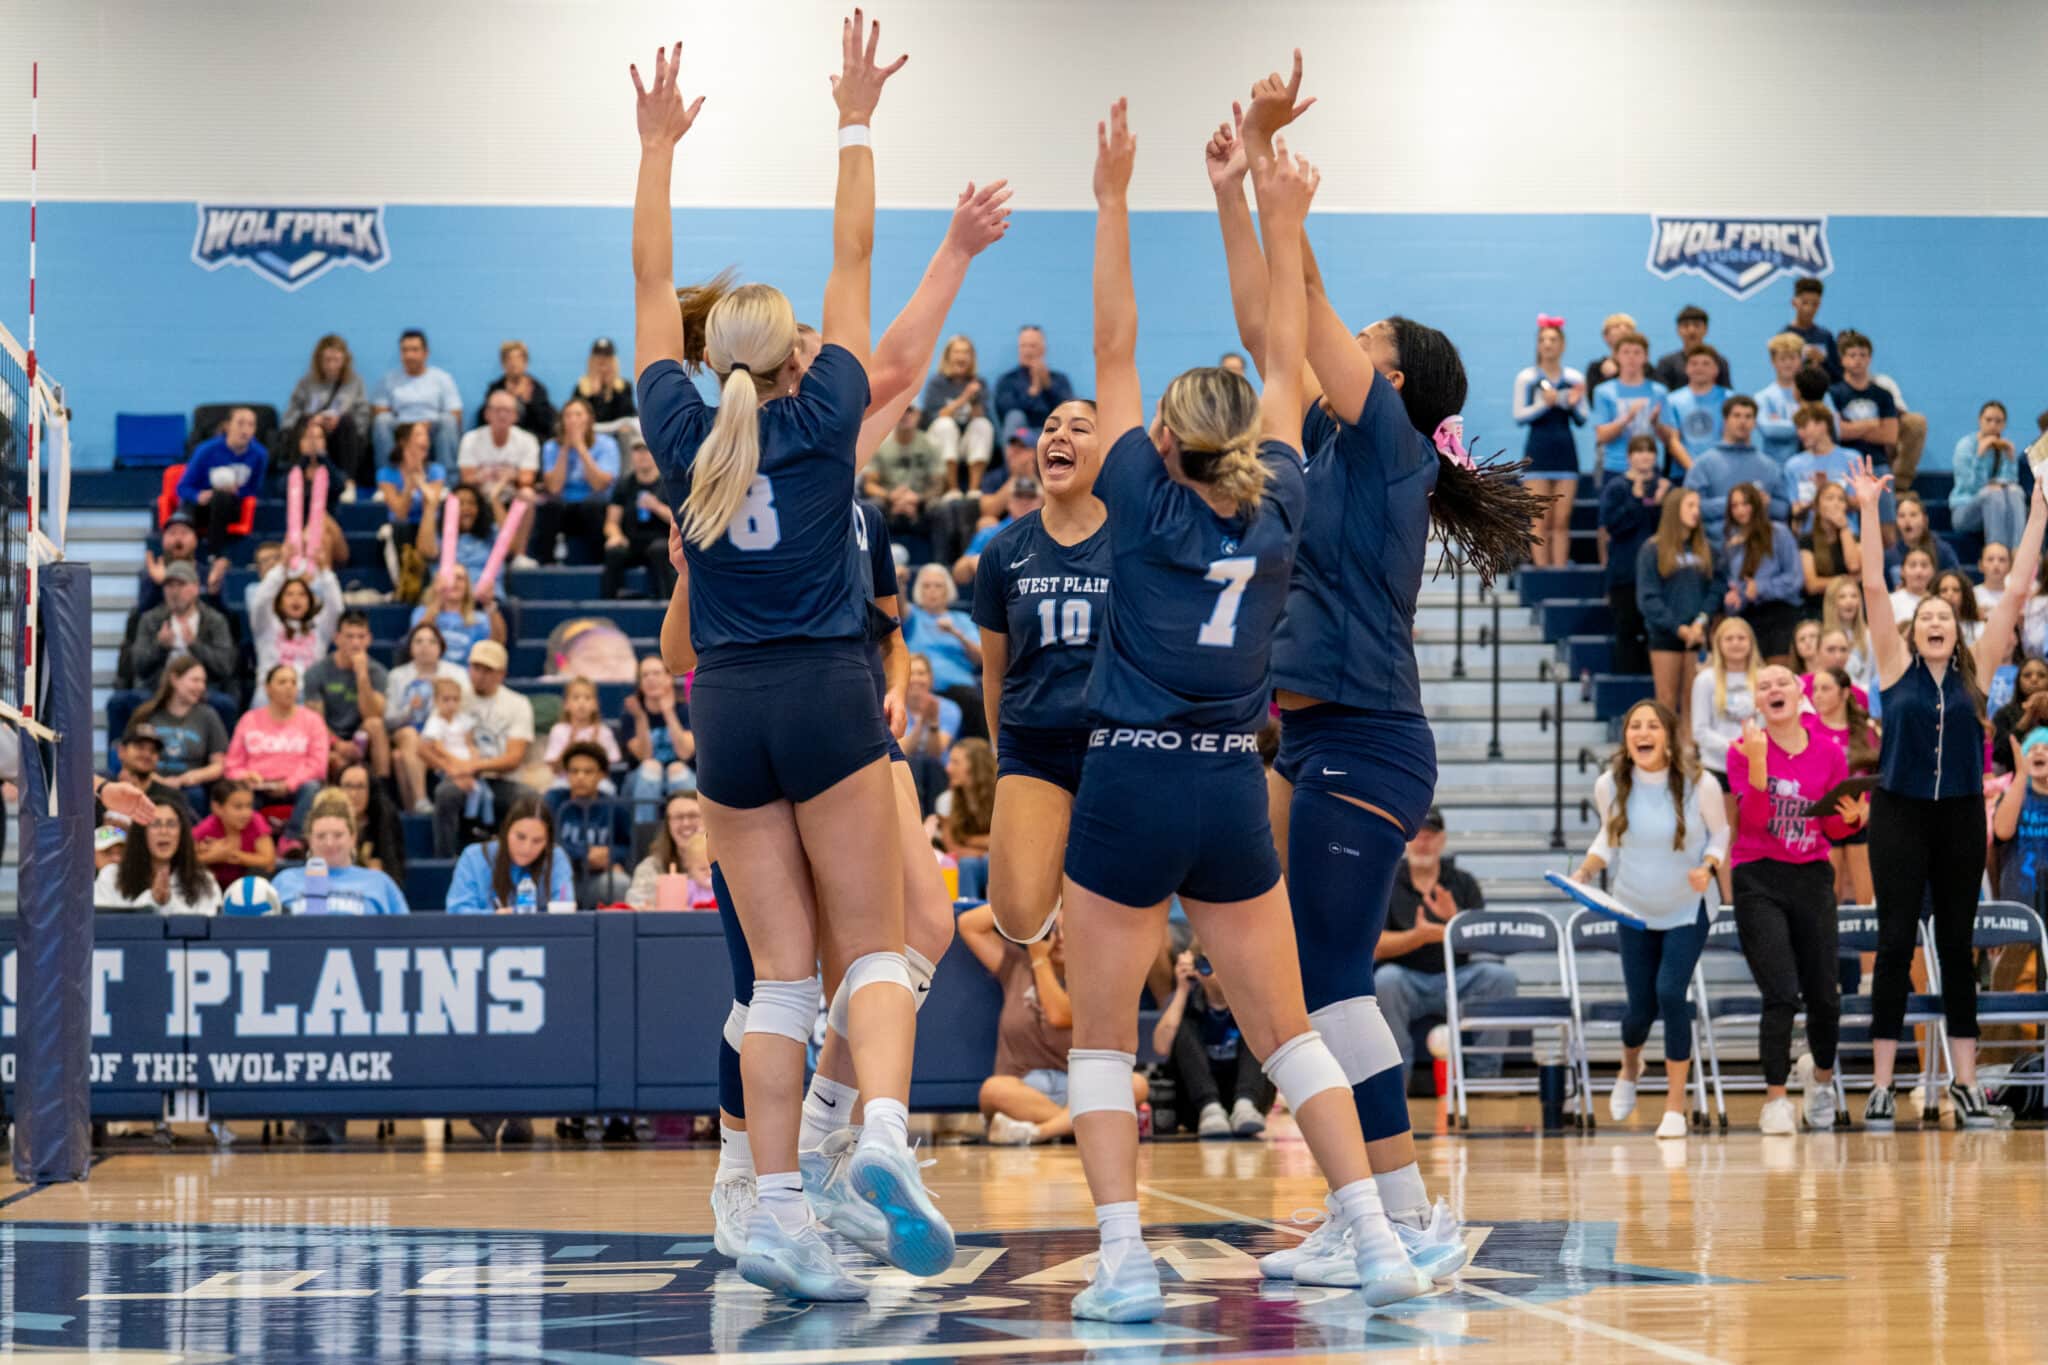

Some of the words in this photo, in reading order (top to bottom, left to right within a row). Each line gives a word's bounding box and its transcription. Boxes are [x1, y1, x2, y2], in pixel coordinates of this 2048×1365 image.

[201, 208, 381, 256] WOLFPACK
[1655, 221, 1825, 267] WOLFPACK
[727, 473, 782, 551] 8
[1017, 576, 1060, 595] WEST
[1063, 576, 1110, 593] PLAIN
[1197, 556, 1257, 648] 7
[1037, 598, 1092, 648] 10
[1110, 728, 1182, 750] PRO
[1223, 733, 1259, 753] PR
[1461, 921, 1497, 938] WEST
[1499, 921, 1546, 939] PLAINS
[1581, 920, 1617, 936] WEST
[1982, 916, 2029, 932] PLAINS
[166, 946, 546, 1037] PLAINS
[132, 1053, 198, 1083] THE
[208, 1051, 392, 1083] WOLFPACK
